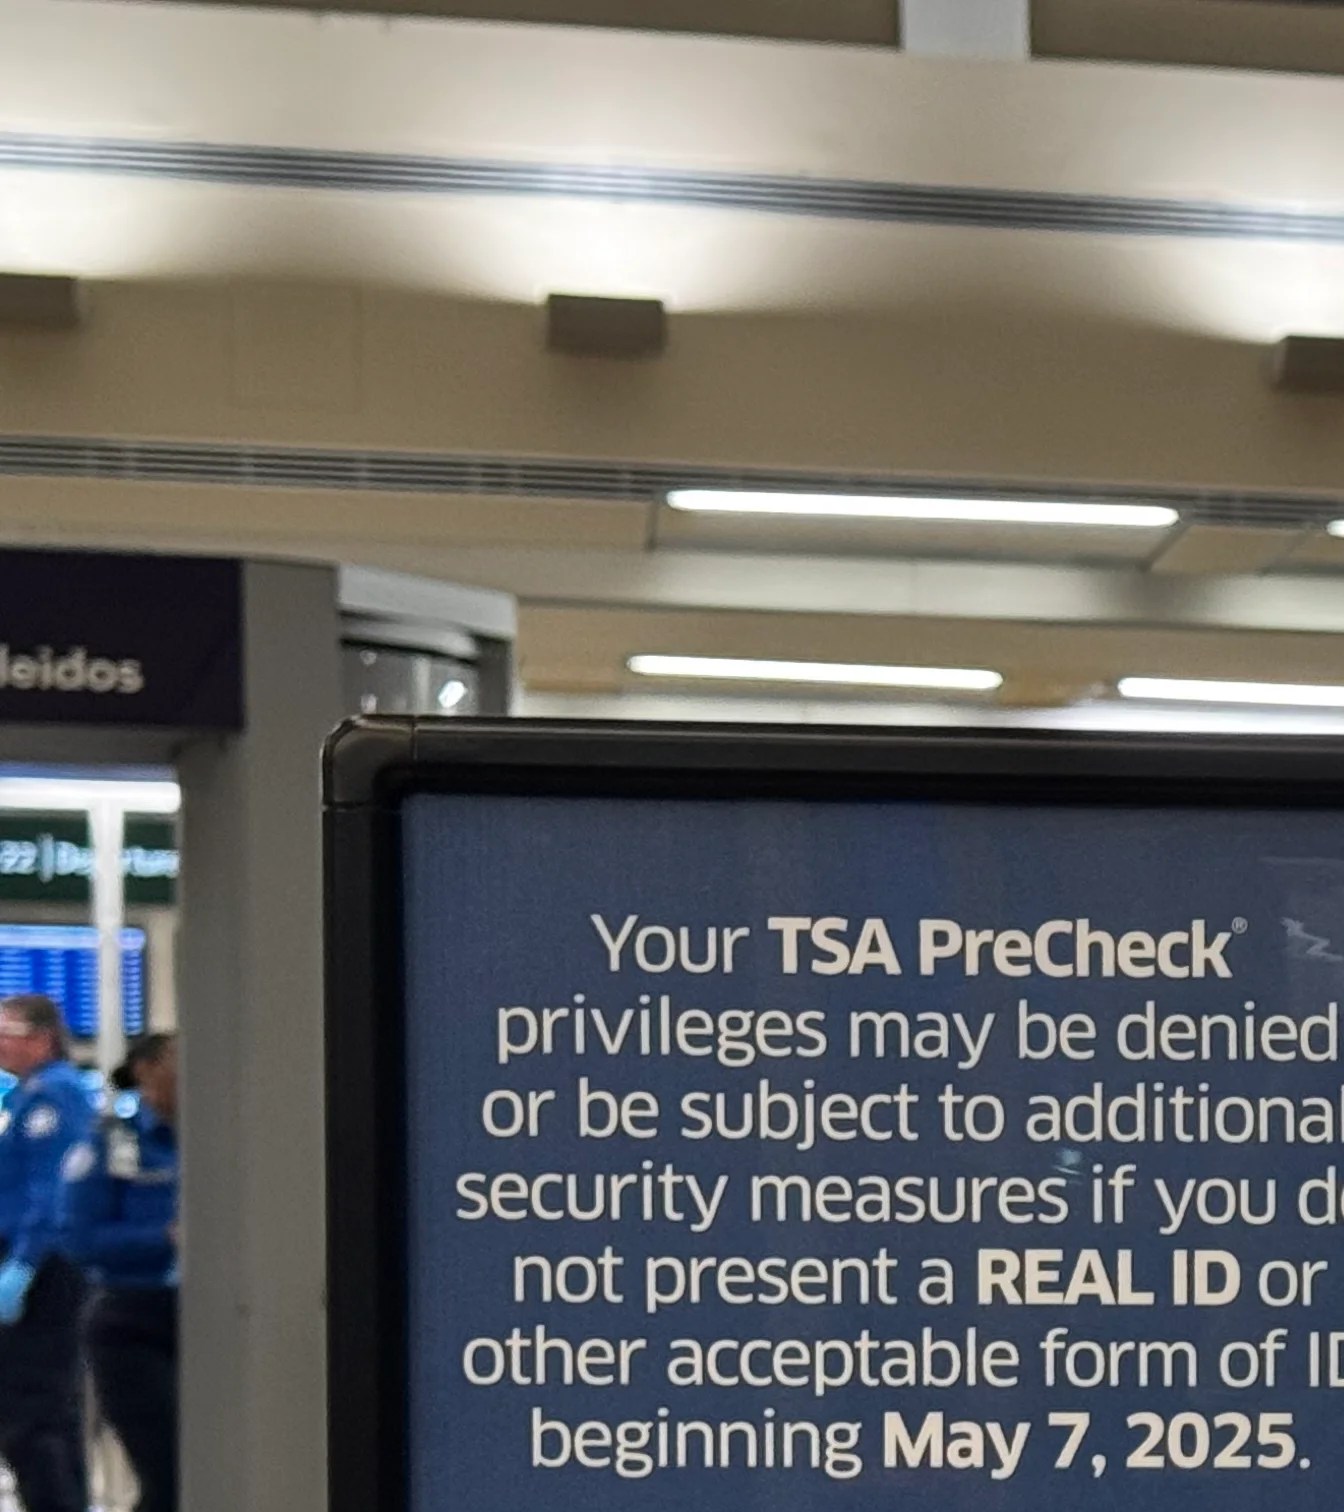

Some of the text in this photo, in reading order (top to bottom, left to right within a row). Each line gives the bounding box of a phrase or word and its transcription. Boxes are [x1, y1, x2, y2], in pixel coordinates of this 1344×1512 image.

[591, 914, 749, 973] Your
[768, 917, 901, 975] TSA
[499, 994, 1337, 1069] privileges may be denied
[483, 1090, 555, 1137] or
[580, 1077, 658, 1138] be
[681, 1079, 918, 1150] subject
[938, 1084, 1004, 1141] to
[457, 1160, 728, 1232] security
[752, 1179, 1070, 1223] measures
[1093, 1164, 1136, 1223] if
[1155, 1179, 1275, 1234] you
[515, 1246, 1328, 1313] not present a REAL ID or
[464, 1325, 646, 1385] other
[668, 1327, 1019, 1396] acceptable
[1040, 1328, 1196, 1387] form
[1220, 1329, 1288, 1387] of
[533, 1407, 1310, 1479] beginning May 7, 2025.
